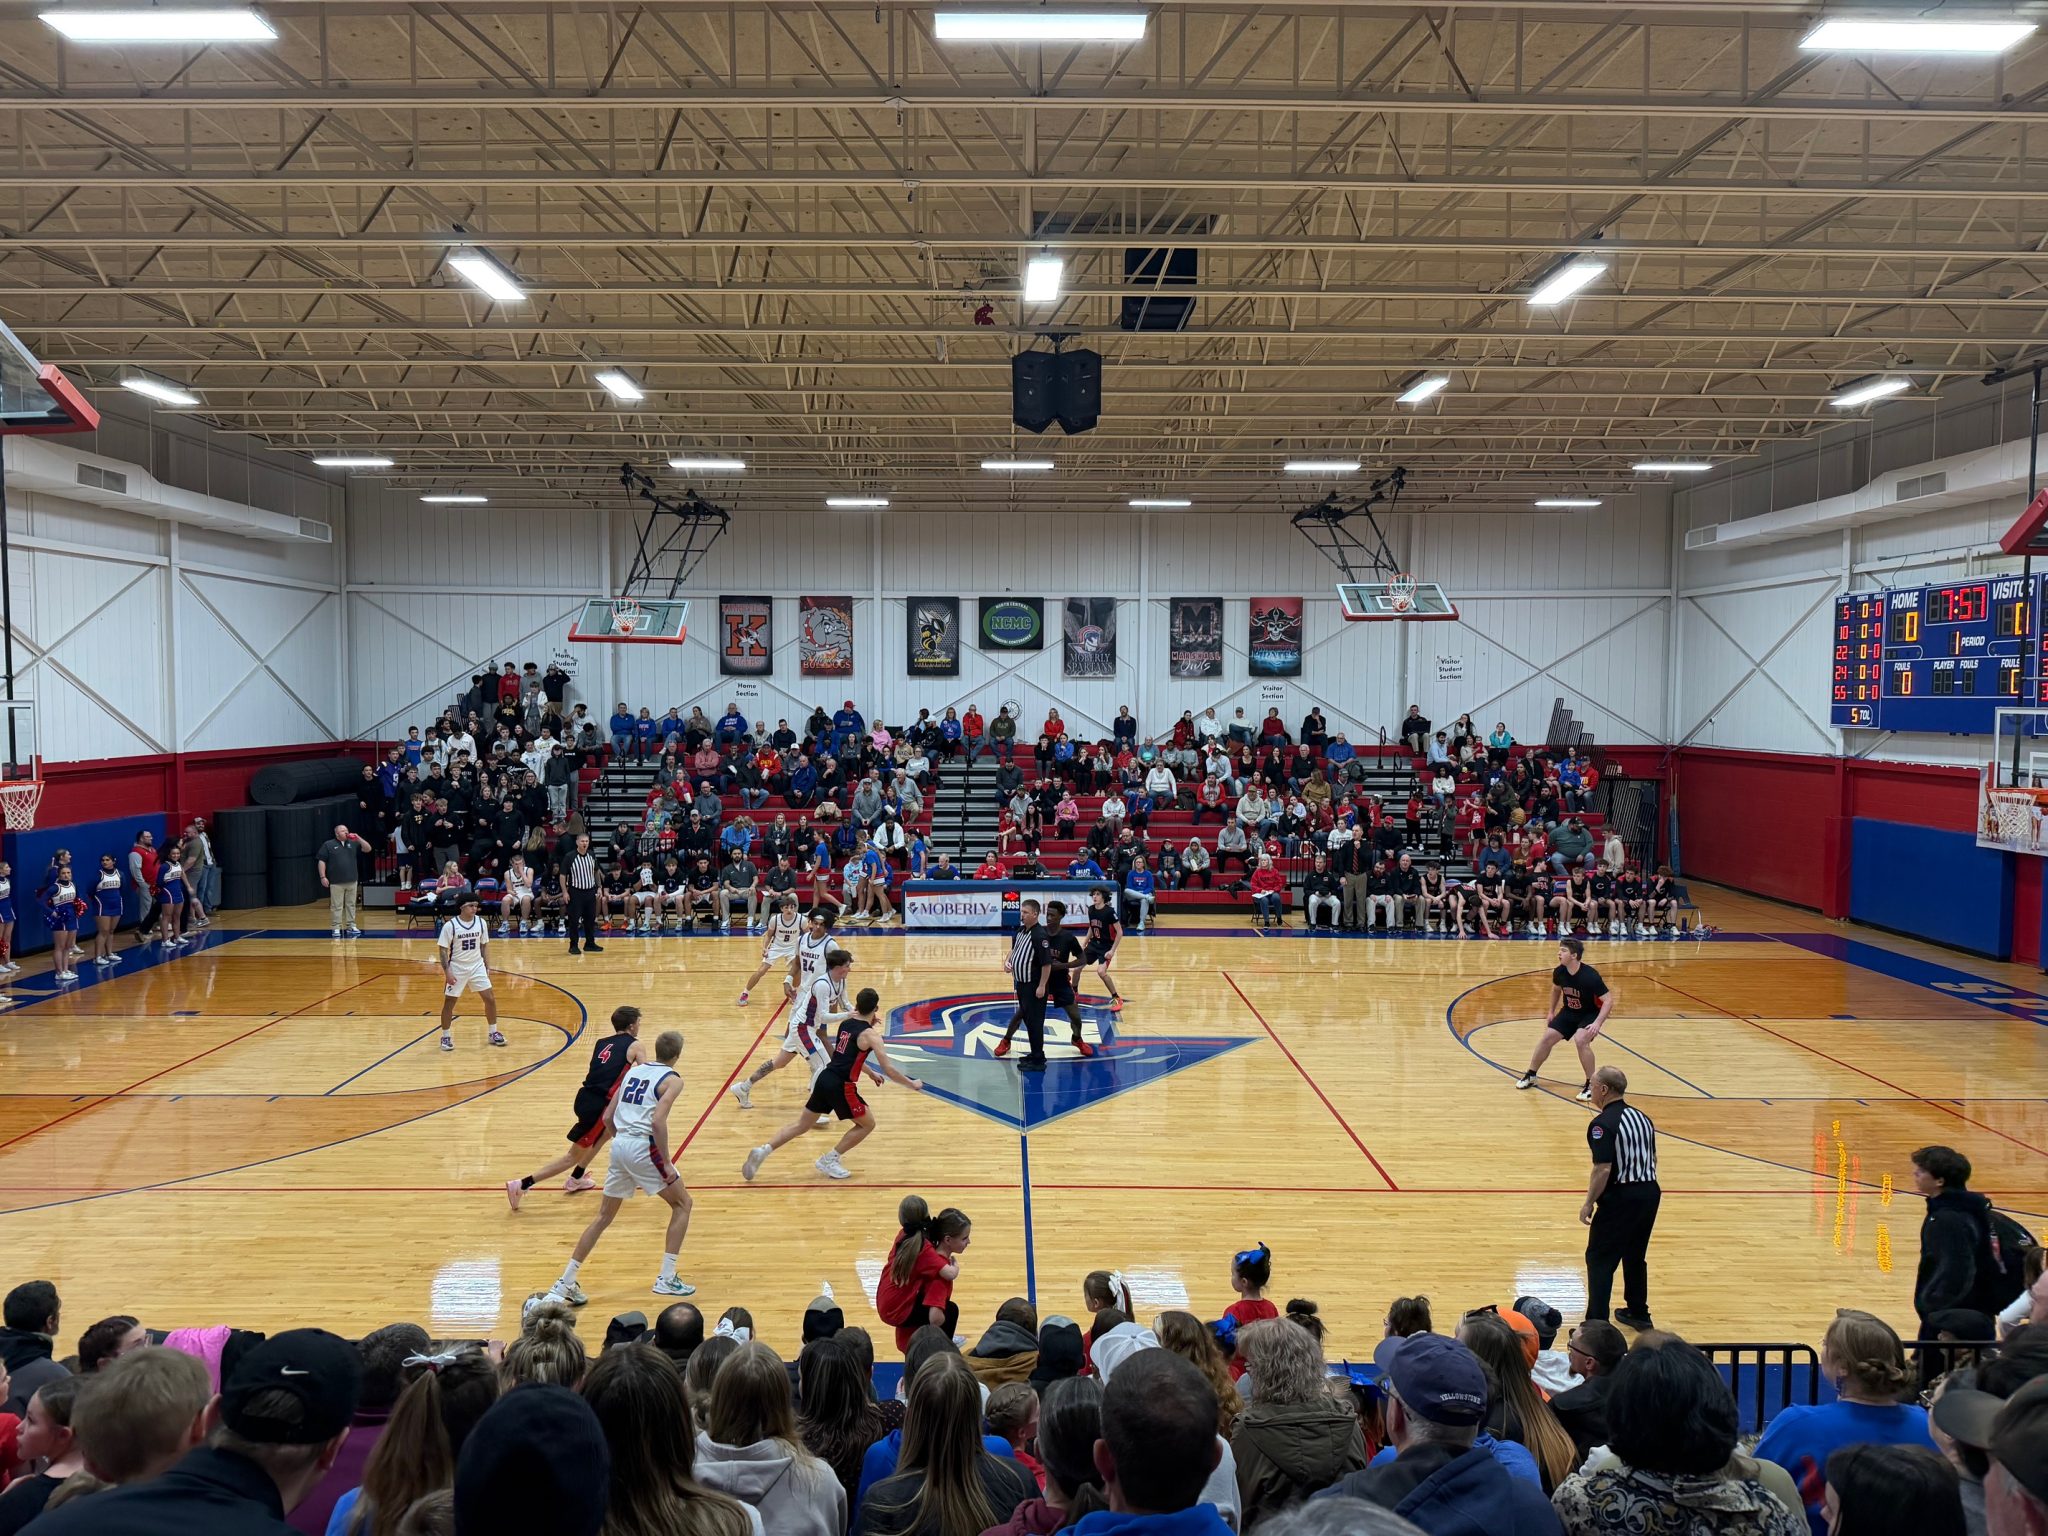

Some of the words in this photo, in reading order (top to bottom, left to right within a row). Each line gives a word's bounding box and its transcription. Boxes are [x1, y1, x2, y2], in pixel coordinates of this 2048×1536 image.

[1891, 591, 1919, 609] HOME
[1941, 586, 1986, 620] 7:57
[1861, 602, 1869, 618] 0
[1875, 601, 1882, 617] 0
[991, 616, 1032, 630] NCMC
[1840, 625, 1849, 640] 10
[1861, 623, 1868, 639] 0
[1874, 622, 1881, 638] 0
[1905, 611, 1919, 642] 0
[725, 614, 768, 657] K
[1955, 631, 1960, 655] 1
[1961, 635, 1986, 647] PERIOD
[1070, 653, 1110, 662] MOBERLY
[1171, 651, 1222, 661] MARSHALL
[1836, 645, 1848, 660] 22
[1860, 644, 1867, 660] 0
[1873, 643, 1880, 659] 0
[1066, 661, 1112, 671] SPARTANS
[1180, 658, 1211, 672] Owls
[1835, 665, 1847, 680] 24
[1859, 664, 1867, 680] 0
[1872, 664, 1879, 679] 0
[1893, 662, 1911, 671] FOULS
[1933, 660, 1955, 670] PLAYER
[1959, 659, 1979, 669] FOULS
[1902, 671, 1912, 695] 0
[1834, 685, 1846, 700] 55
[1859, 684, 1866, 700] 0
[1871, 684, 1879, 700] 0
[1851, 707, 1858, 723] 5
[1859, 709, 1871, 721] TOL
[920, 902, 991, 915] MOBERLY
[1002, 901, 1019, 909] POSS
[457, 931, 480, 939] MOBERLY
[461, 939, 476, 951] 55
[802, 958, 815, 974] 24
[597, 1043, 614, 1064] 4
[621, 1077, 650, 1106] 22
[1439, 1392, 1482, 1404] YELLOWSTONE
